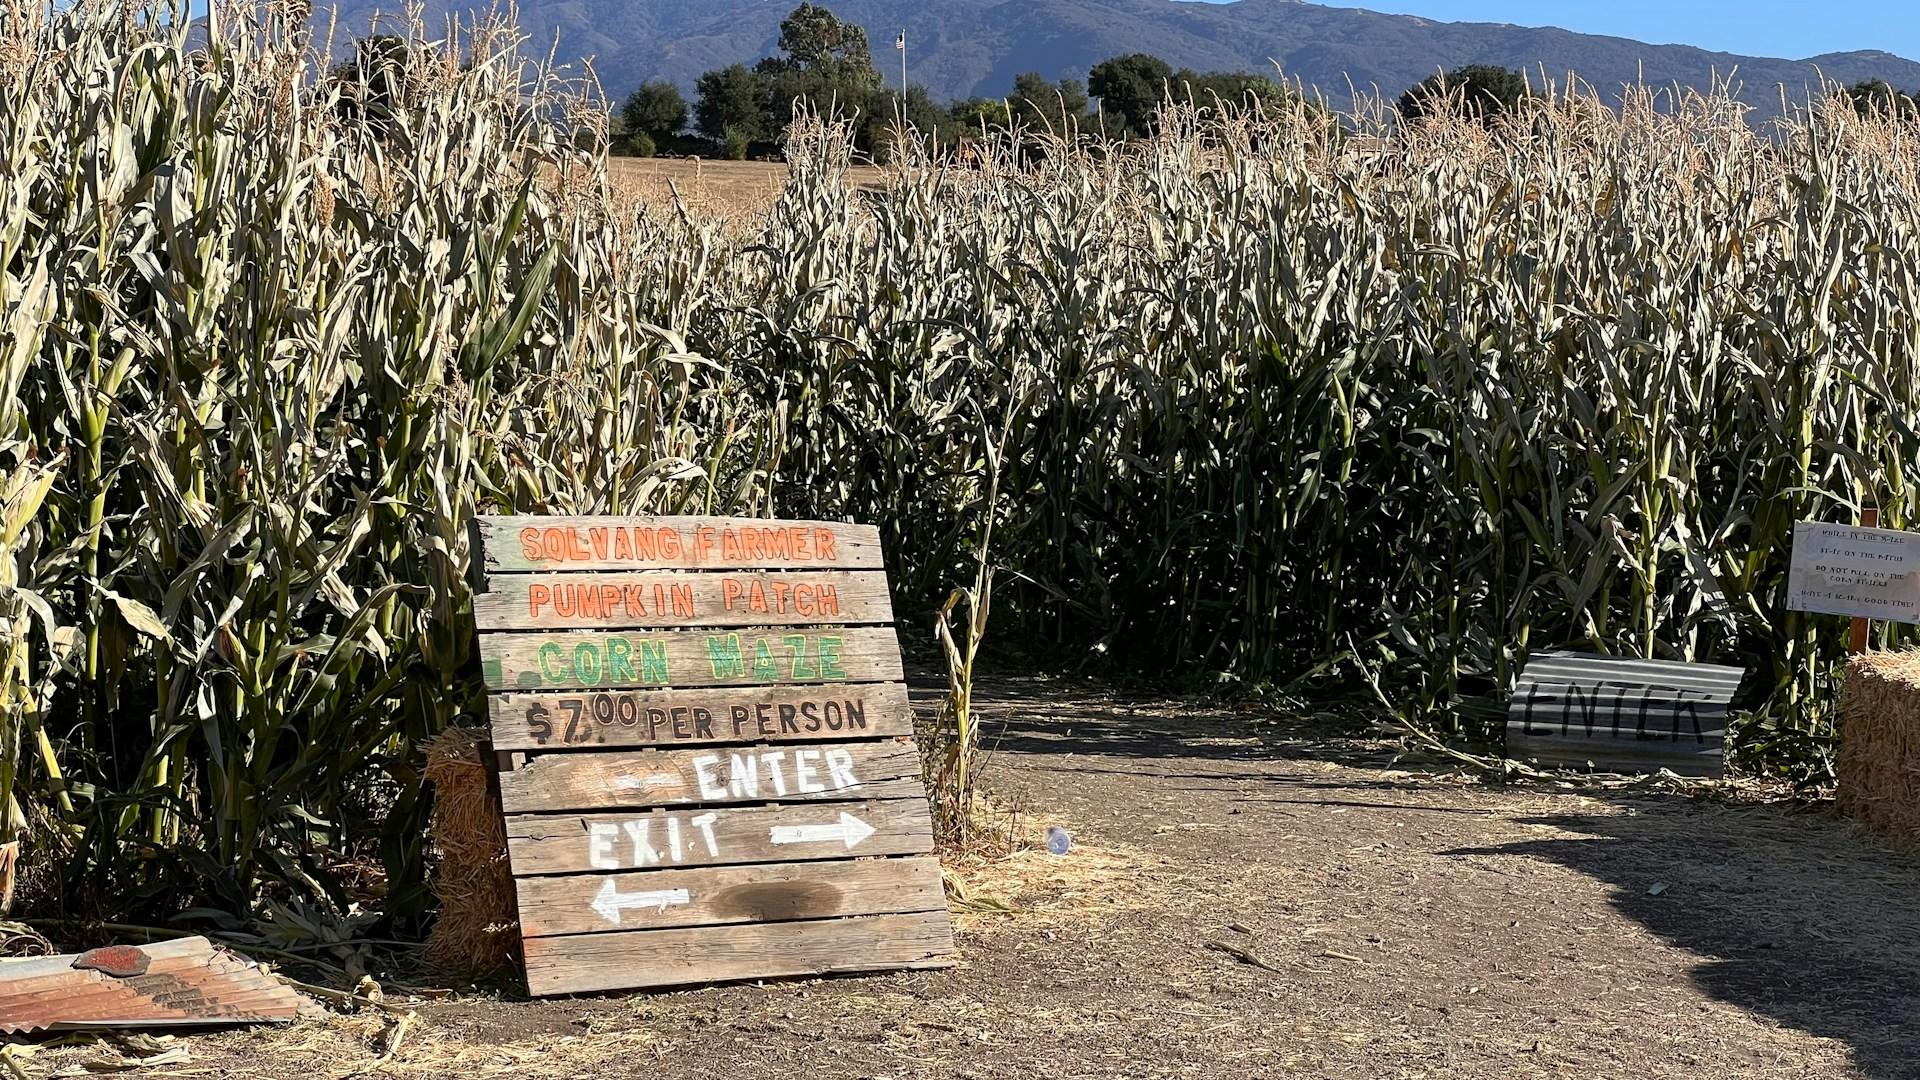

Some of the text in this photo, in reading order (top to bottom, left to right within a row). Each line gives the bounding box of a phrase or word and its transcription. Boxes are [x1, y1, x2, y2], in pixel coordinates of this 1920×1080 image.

[519, 526, 837, 562] SOLVANG FARMER
[1845, 549, 1855, 557] ON
[1860, 551, 1875, 559] THE
[1850, 532, 1858, 540] IN
[1862, 533, 1877, 541] THE
[1830, 567, 1848, 575] NOT
[1873, 571, 1885, 579] ON
[529, 578, 840, 619] PUMPKIN PATCH
[1864, 597, 1888, 605] GOOD
[537, 632, 847, 687] CORN MAZE
[646, 705, 715, 741] PER
[730, 698, 868, 736] PERSON
[1523, 681, 1713, 744] ENTER
[691, 748, 863, 801] ENTER
[588, 812, 720, 870] EXIT
